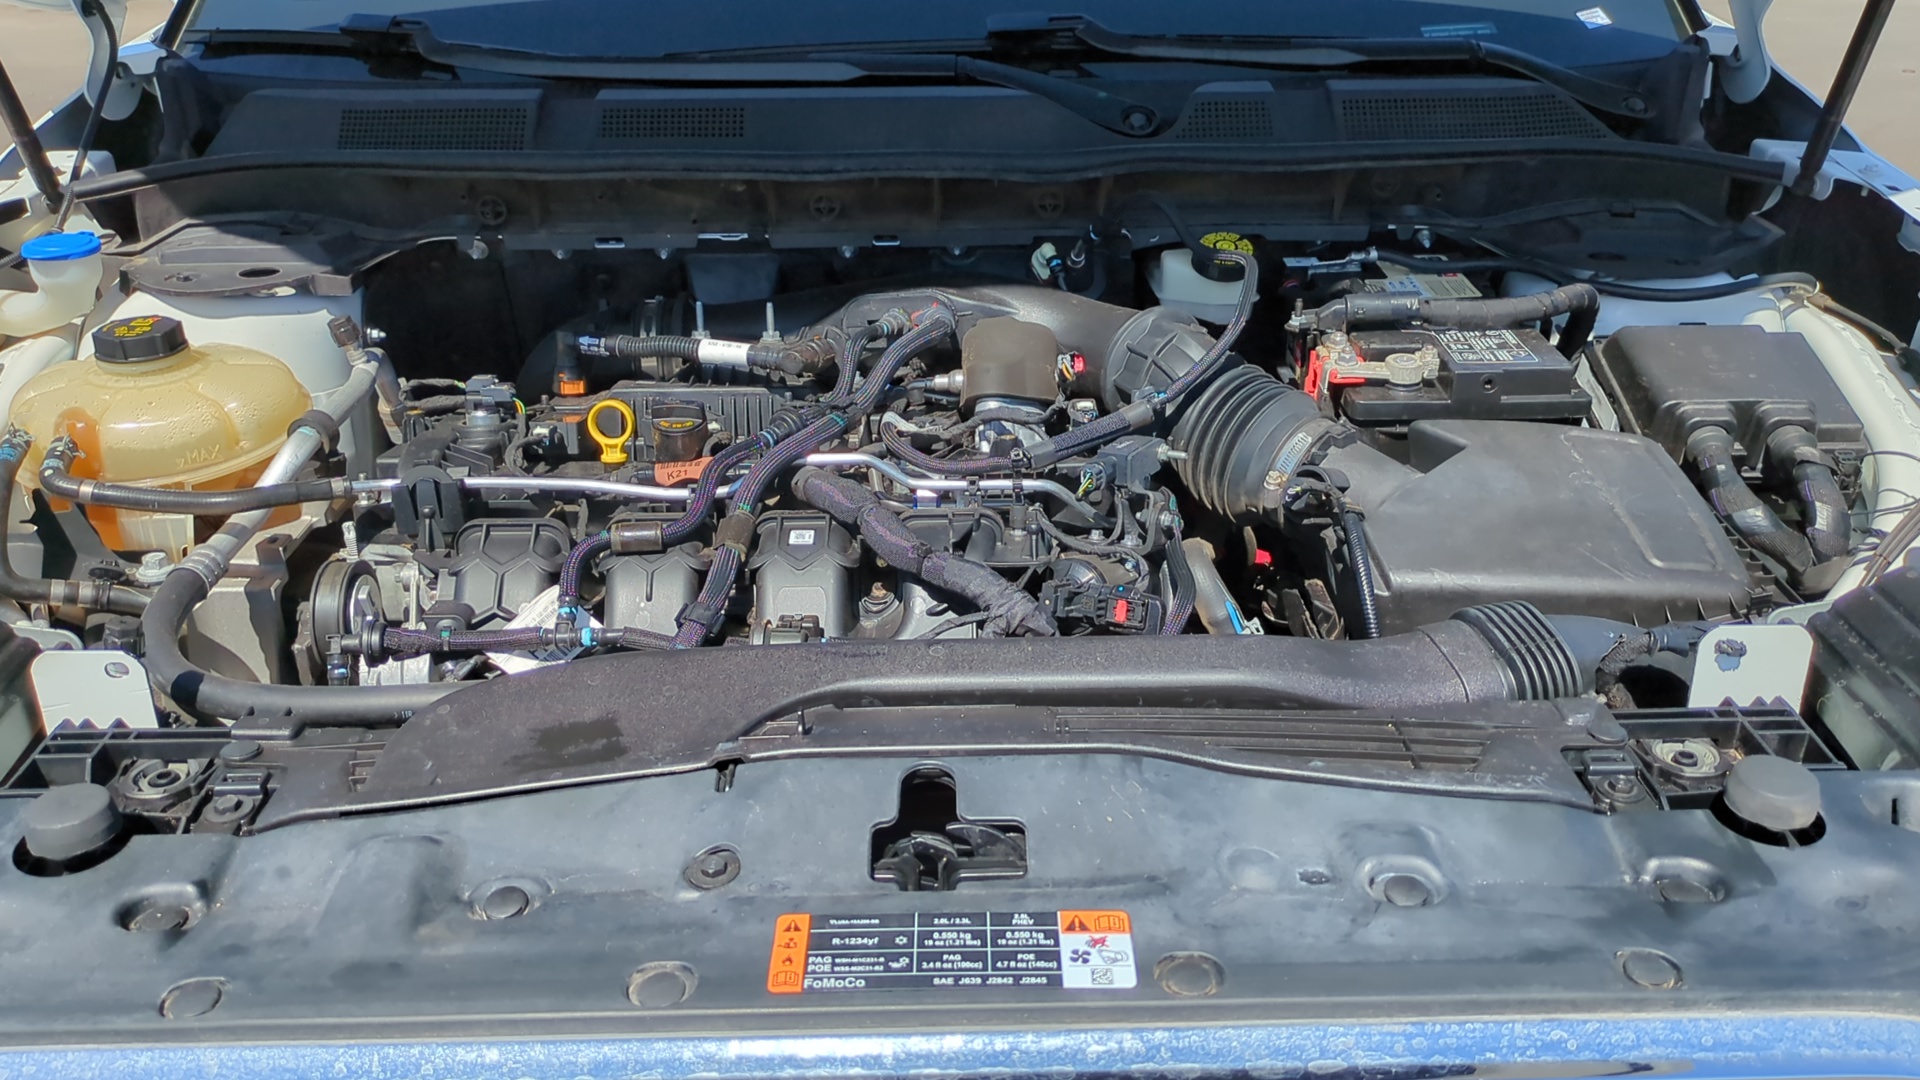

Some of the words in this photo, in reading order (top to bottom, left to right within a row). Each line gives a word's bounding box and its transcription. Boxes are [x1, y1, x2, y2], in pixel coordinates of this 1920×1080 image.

[186, 444, 223, 465] MAX
[666, 469, 688, 481] K21
[960, 932, 972, 940] kg
[1032, 931, 1044, 940] kg
[832, 937, 879, 945] R-1234yf
[954, 961, 982, 969] (100cc)
[1028, 960, 1058, 969] (140cc)
[804, 978, 866, 988] FoMoCo
